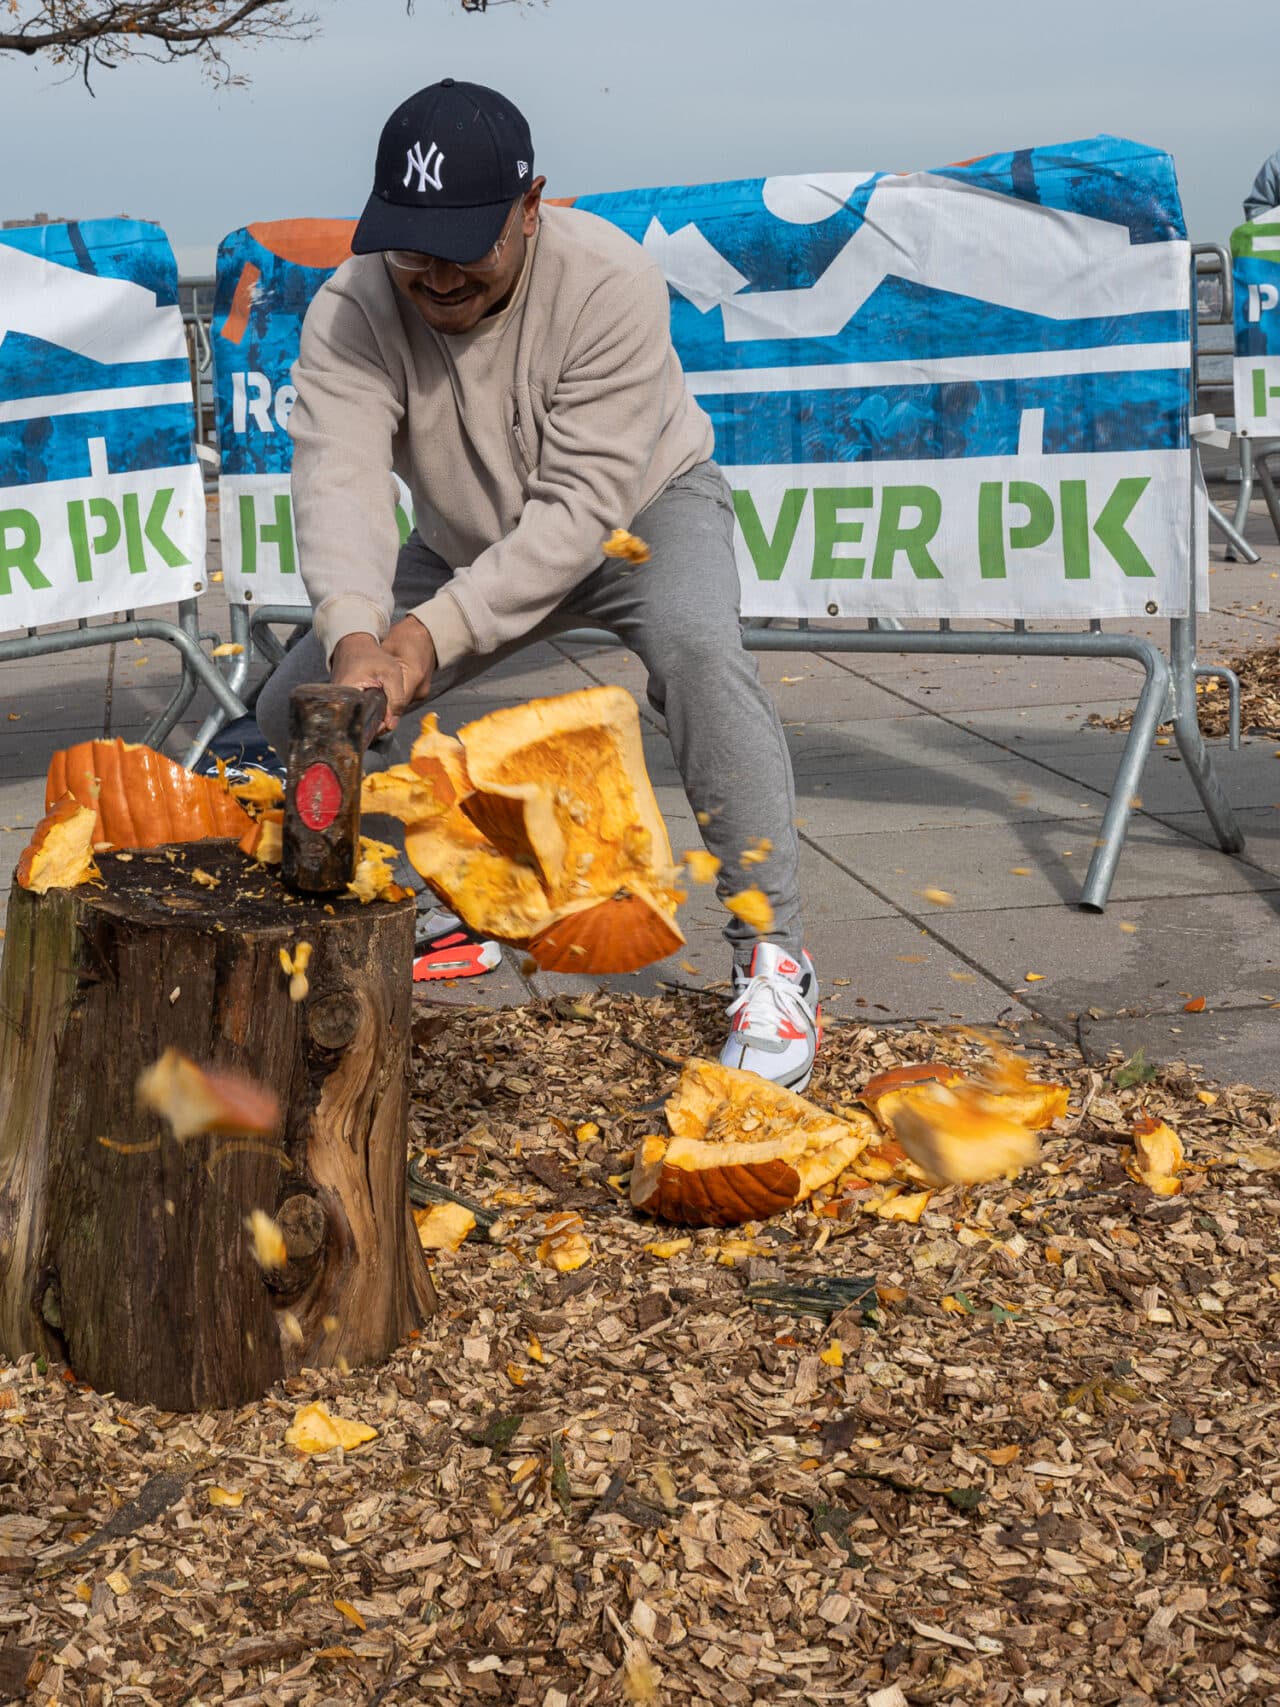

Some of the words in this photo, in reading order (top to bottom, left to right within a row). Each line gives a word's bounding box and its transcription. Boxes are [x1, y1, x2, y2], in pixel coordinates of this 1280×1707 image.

[403, 141, 445, 192] NY
[68, 488, 192, 583] PK
[731, 486, 943, 579] VER
[979, 477, 1157, 579] PK
